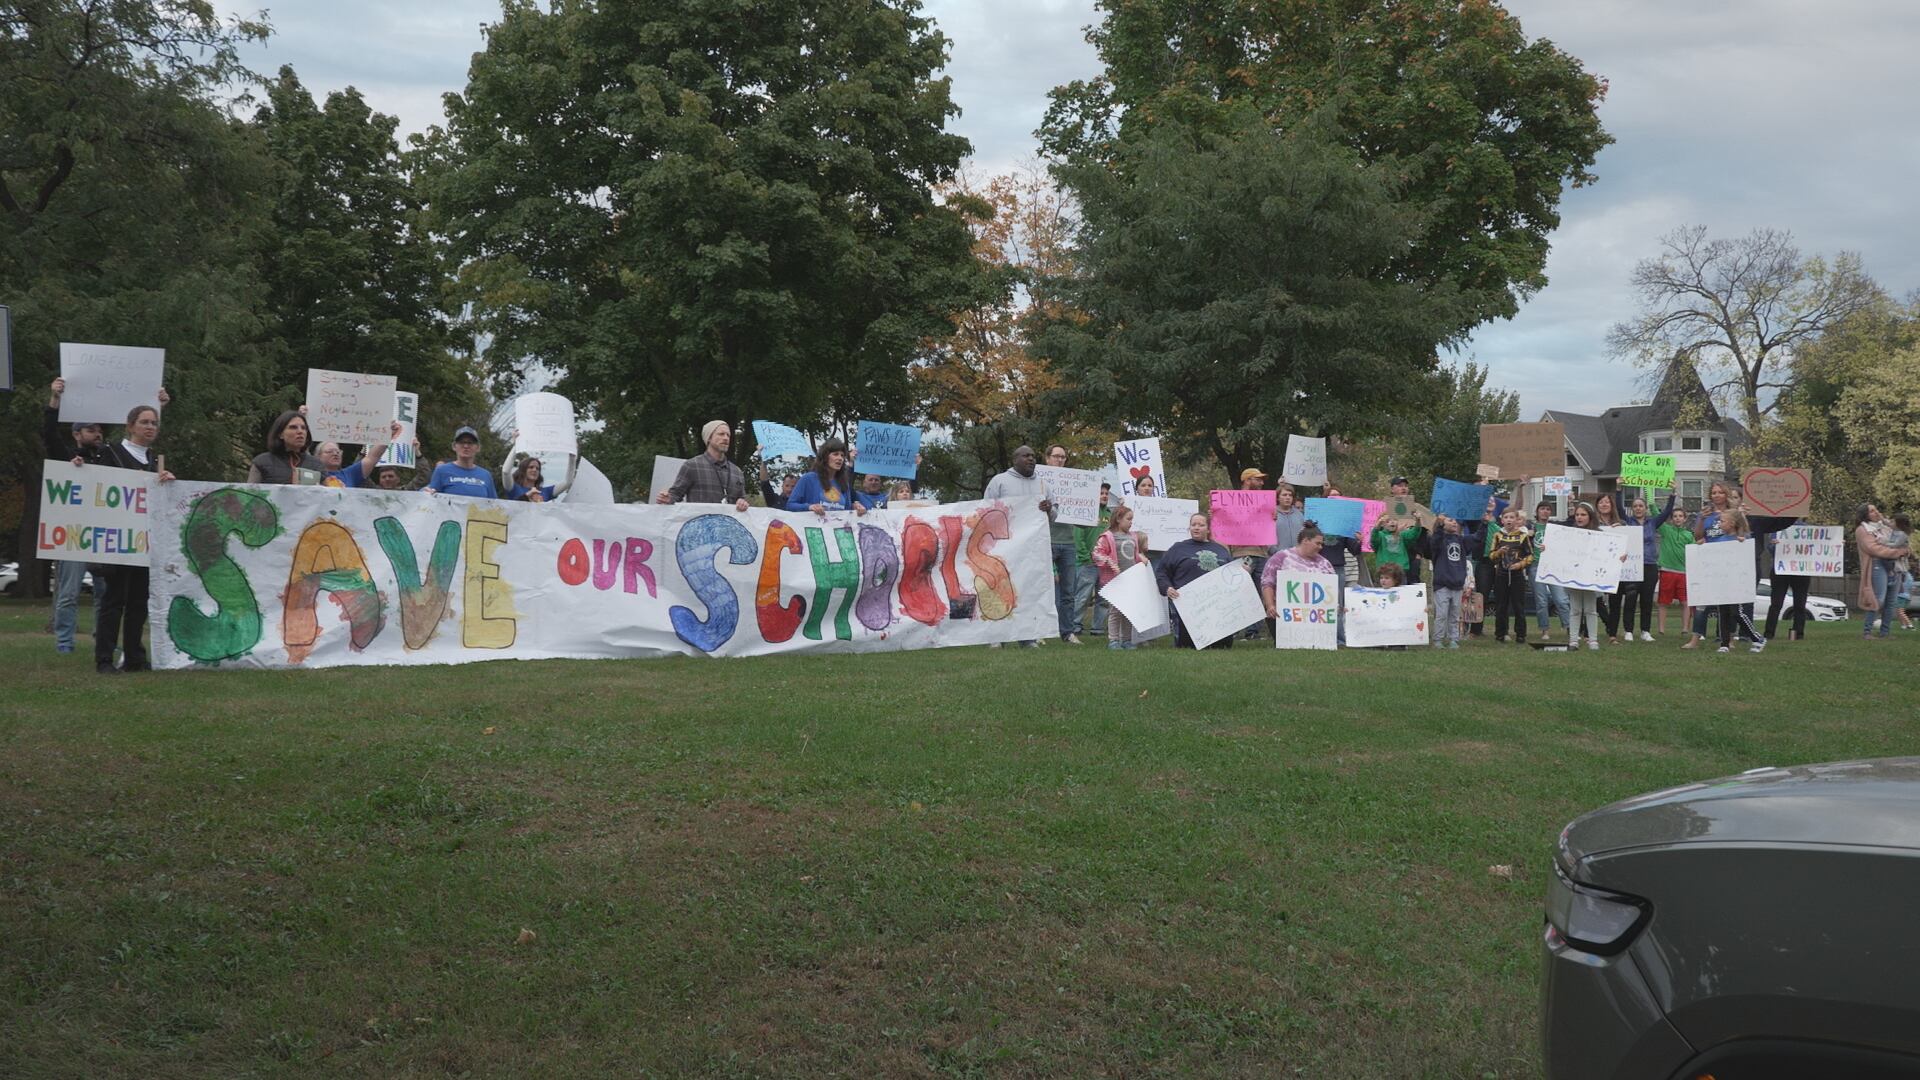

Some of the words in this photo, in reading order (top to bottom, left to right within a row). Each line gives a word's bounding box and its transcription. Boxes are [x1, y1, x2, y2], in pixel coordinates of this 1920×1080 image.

[96, 376, 131, 393] LOVE
[320, 371, 360, 389] Strong
[321, 387, 358, 406] Strong
[397, 396, 414, 424] E
[316, 416, 351, 434] Strong
[864, 426, 891, 445] PAWS
[864, 444, 913, 460] ROOSEVELT
[1117, 442, 1151, 465] We
[1624, 454, 1650, 466] SAVE
[1656, 457, 1671, 468] OUR
[1058, 472, 1081, 480] CLOSE
[1084, 473, 1096, 481] THE
[1072, 480, 1089, 488] OUR
[45, 478, 83, 506] WE
[94, 482, 148, 515] LOVE
[1210, 491, 1254, 507] FLYNN
[1793, 528, 1832, 541] SCHOOL
[1782, 543, 1791, 556] IS
[1795, 543, 1815, 556] NOT
[1816, 543, 1842, 557] JUST
[168, 486, 518, 664] SAVE
[557, 536, 657, 599] OUR
[669, 507, 1017, 653] SCHOOLS
[1777, 560, 1786, 571] A
[1790, 560, 1842, 574] BUILDING
[1286, 580, 1335, 606] KIDS
[1282, 607, 1337, 624] BEFORE
